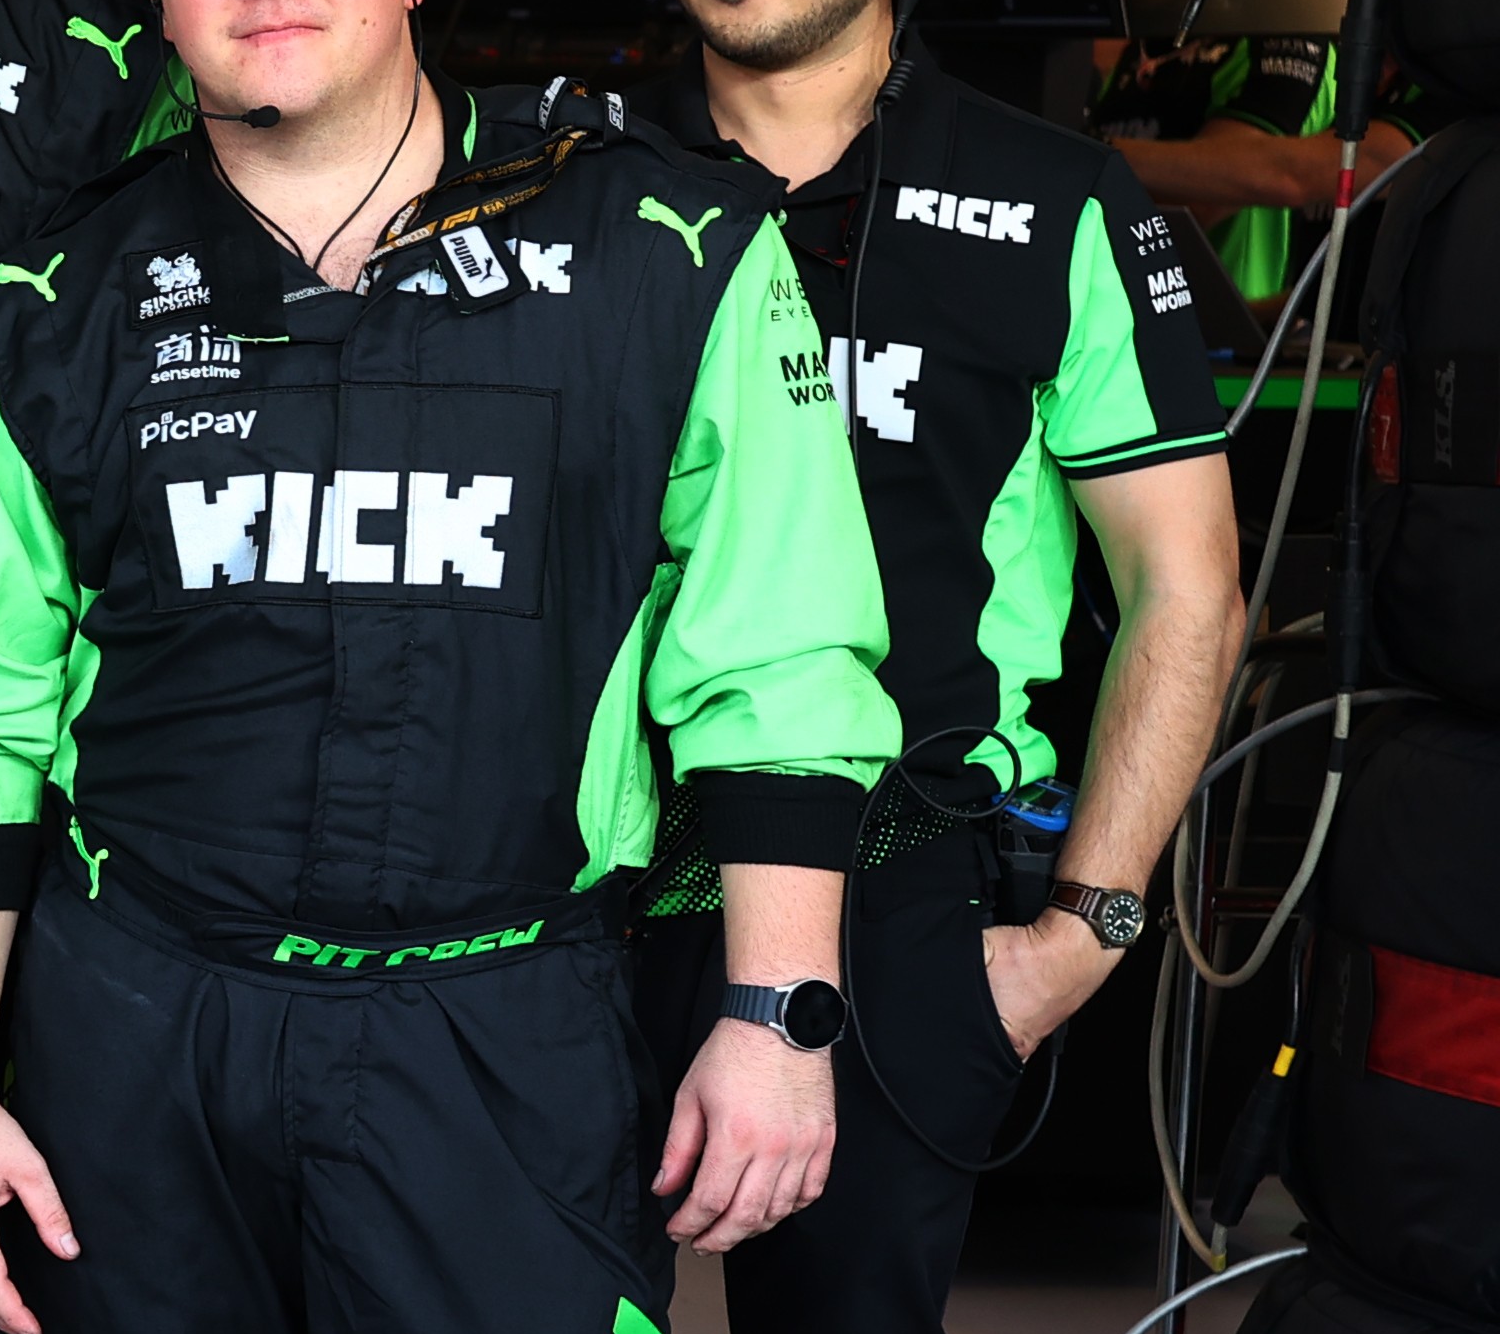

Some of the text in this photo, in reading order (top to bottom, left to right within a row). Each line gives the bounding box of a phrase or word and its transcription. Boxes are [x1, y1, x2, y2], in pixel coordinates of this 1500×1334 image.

[895, 186, 1036, 244] KICK
[448, 235, 482, 280] PUMA
[138, 295, 212, 320] CORPORATIO
[150, 363, 242, 384] sensetime
[140, 410, 257, 449] PicPay
[166, 470, 513, 589] KICK
[273, 933, 386, 969] PIT
